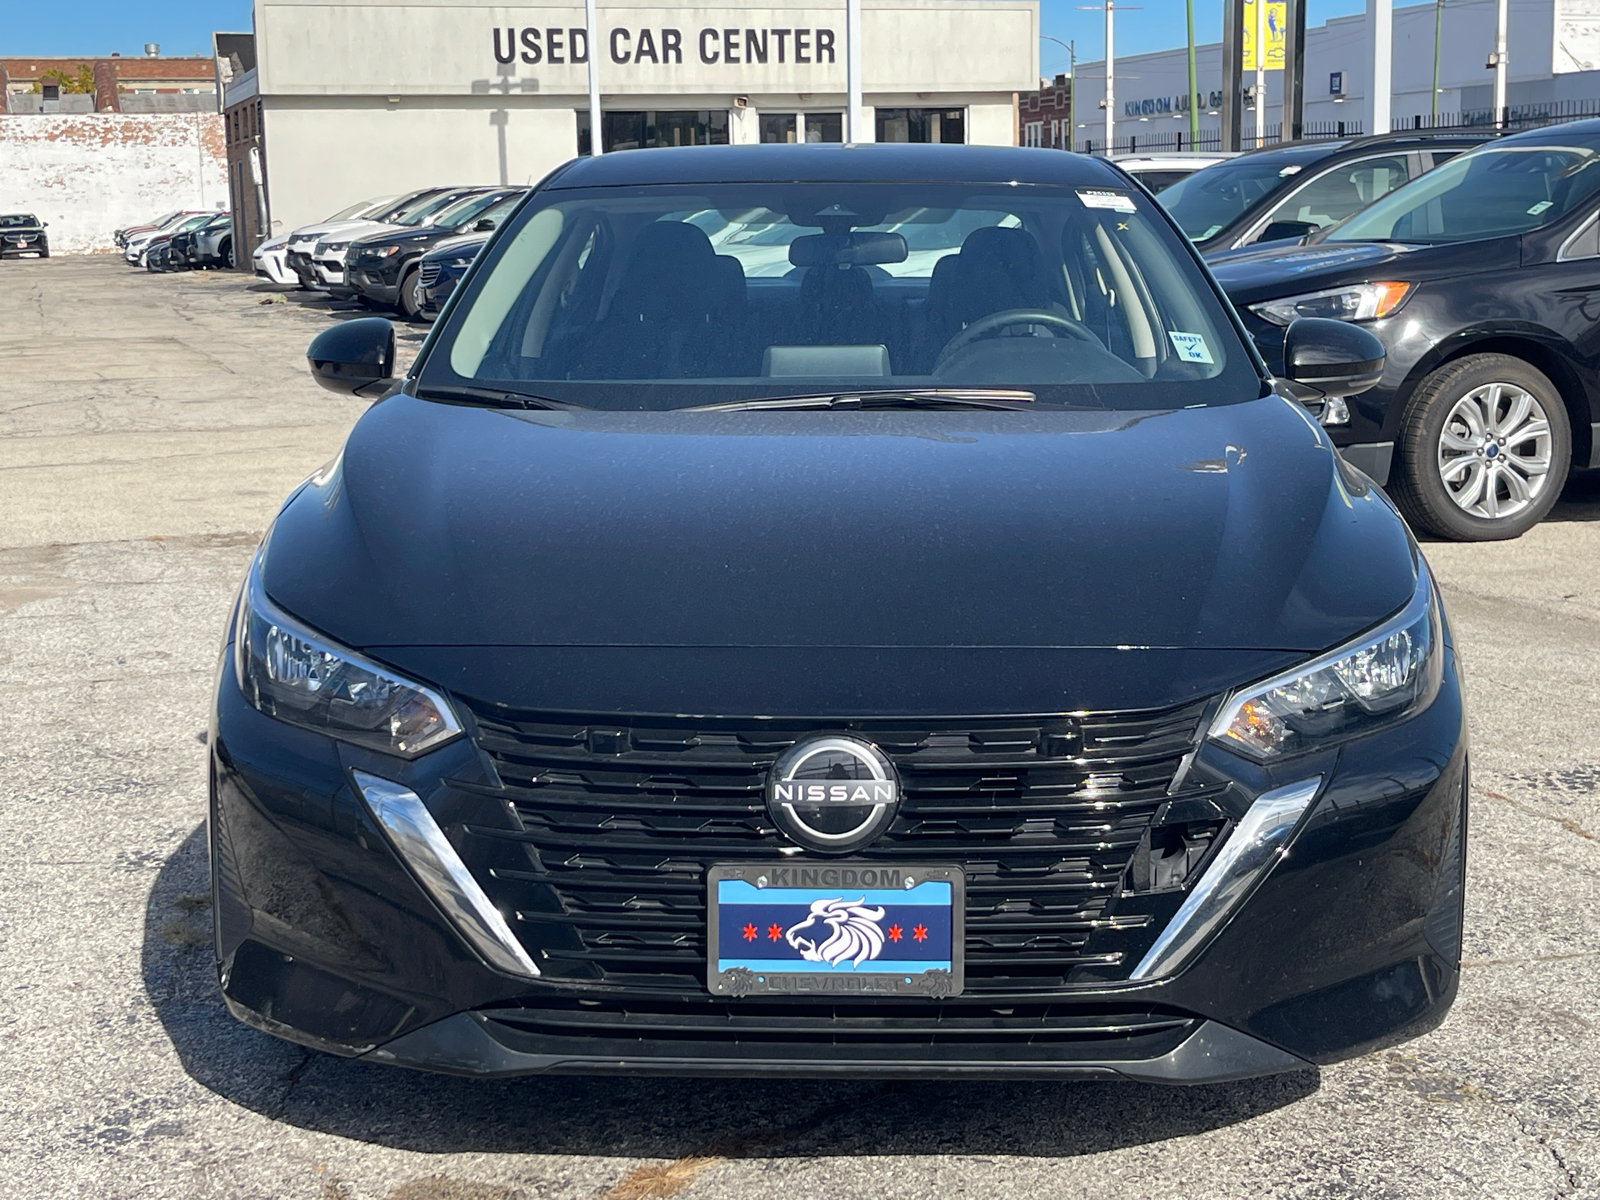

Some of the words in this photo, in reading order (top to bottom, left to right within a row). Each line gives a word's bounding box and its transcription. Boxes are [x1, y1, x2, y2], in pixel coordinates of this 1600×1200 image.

[493, 28, 588, 64] USED
[610, 28, 683, 64] CAR
[699, 28, 836, 64] CENTER
[1125, 97, 1171, 116] KINGDOM
[1173, 335, 1202, 343] SAFETY
[774, 784, 892, 801] NISSAN
[771, 869, 900, 887] KINGDOM
[767, 976, 902, 992] CHEVROLET
